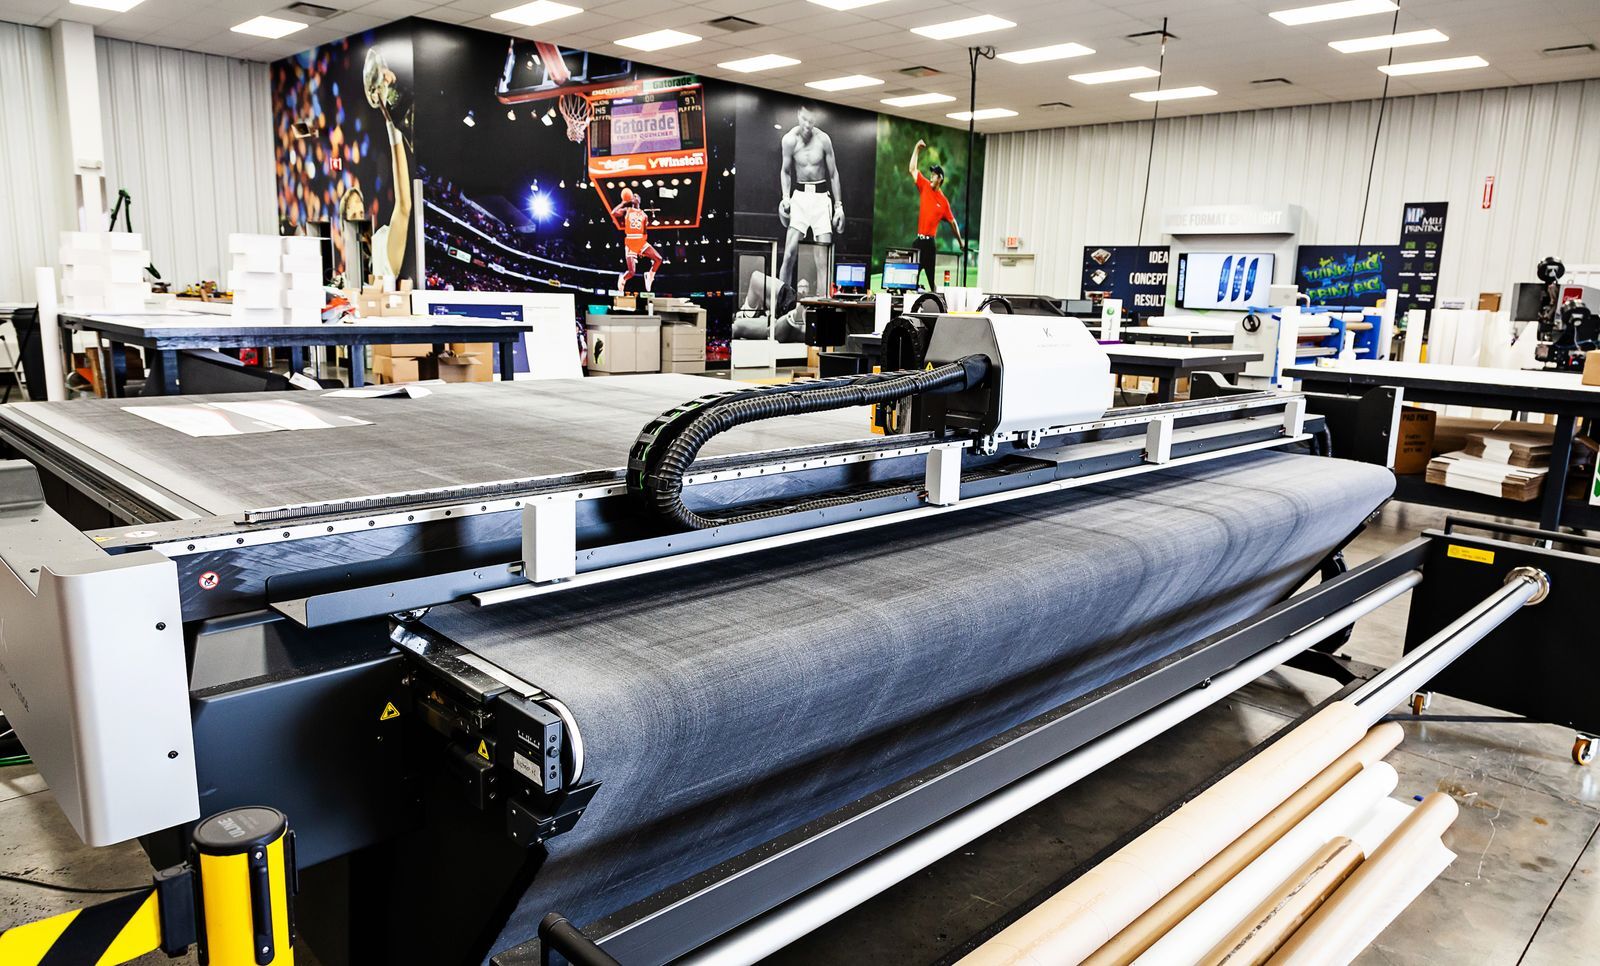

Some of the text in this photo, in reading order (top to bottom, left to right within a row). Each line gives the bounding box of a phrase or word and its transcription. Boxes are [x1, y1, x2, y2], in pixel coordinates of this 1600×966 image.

[652, 76, 692, 90] Gatorade
[614, 115, 675, 135] Gatorade
[658, 155, 704, 167] Winston
[1189, 212, 1229, 226] FORMAT
[1230, 210, 1282, 225] SIGHT
[1404, 207, 1425, 223] MP
[1404, 224, 1443, 234] PRINTING
[1149, 251, 1169, 264] IDEA
[1305, 257, 1380, 279] THINK BIG
[1129, 272, 1168, 285] CONCEPT
[1308, 278, 1381, 299] PRINT BIG
[1134, 294, 1166, 307] RESULT
